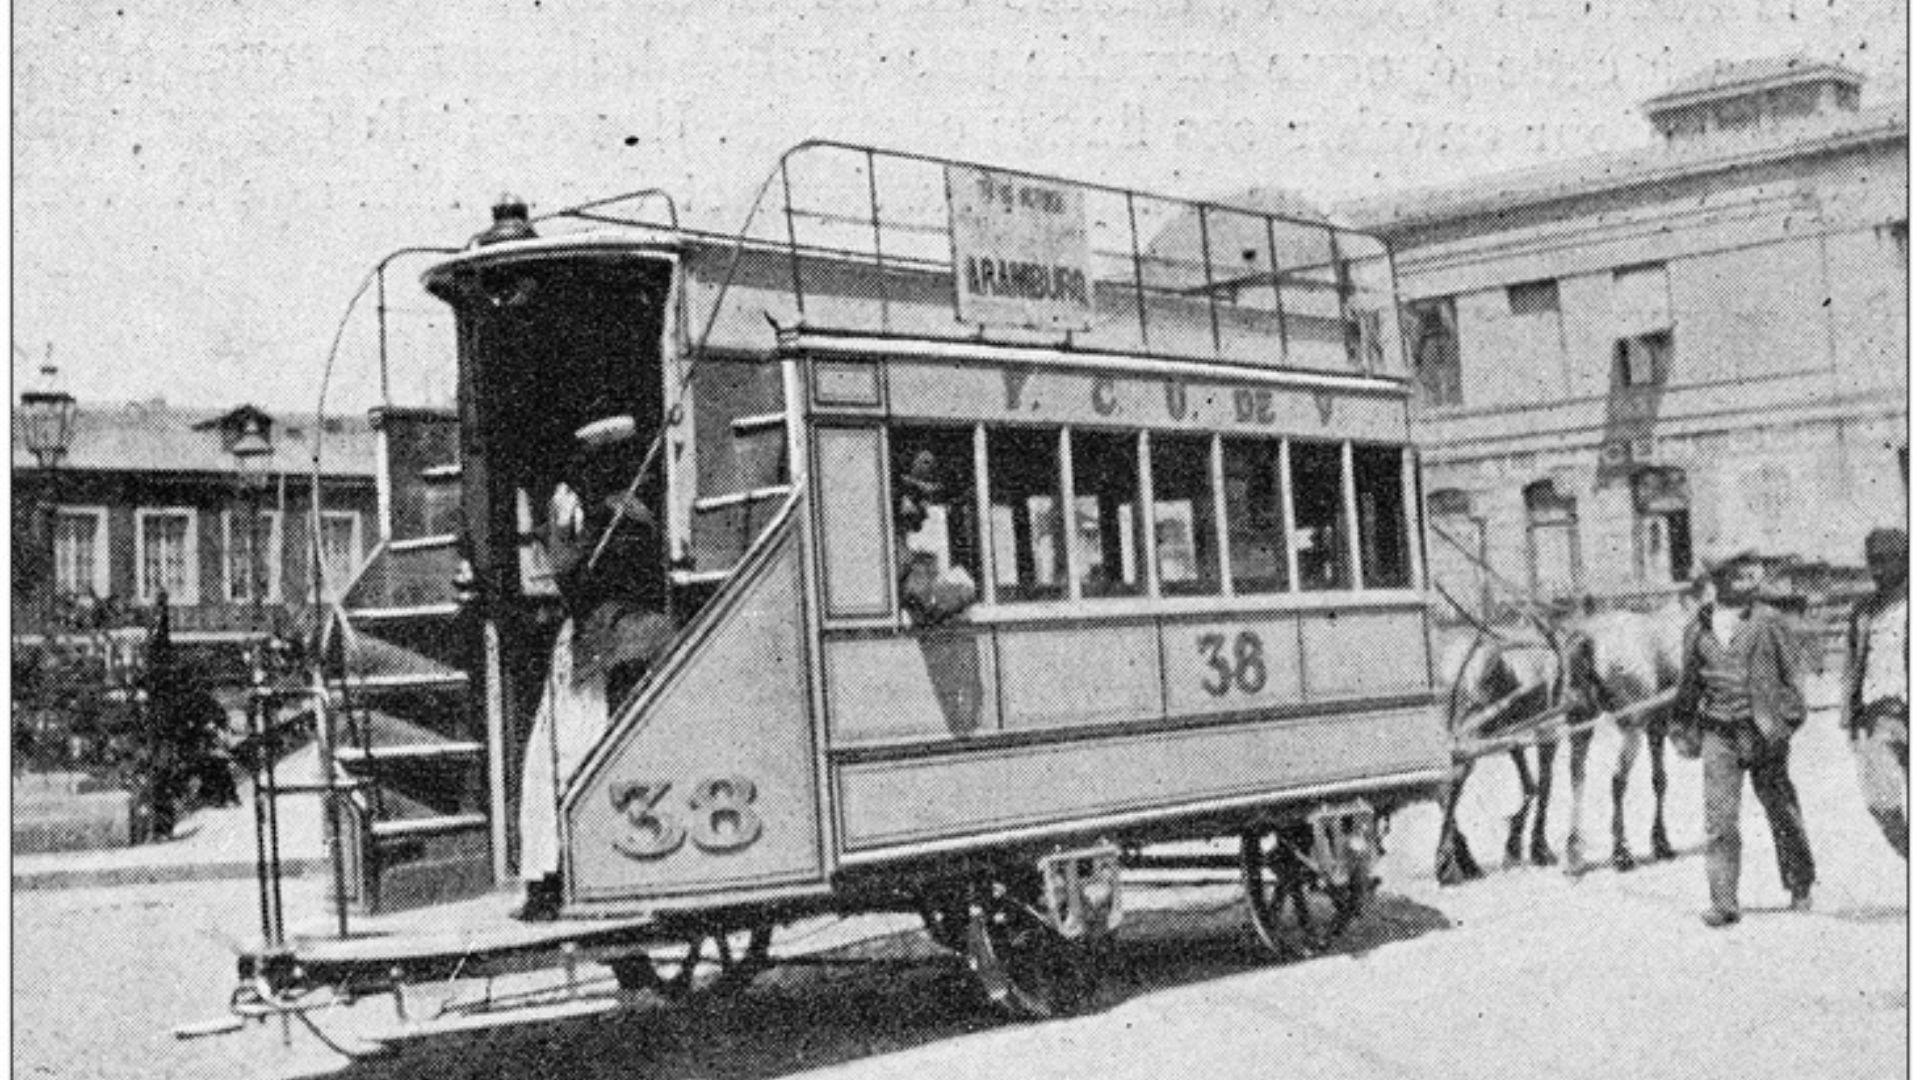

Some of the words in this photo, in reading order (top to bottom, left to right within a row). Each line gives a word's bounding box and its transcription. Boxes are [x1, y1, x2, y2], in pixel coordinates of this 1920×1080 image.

[1233, 387, 1276, 425] DE
[1196, 630, 1267, 698] 38
[608, 775, 763, 863] 38
